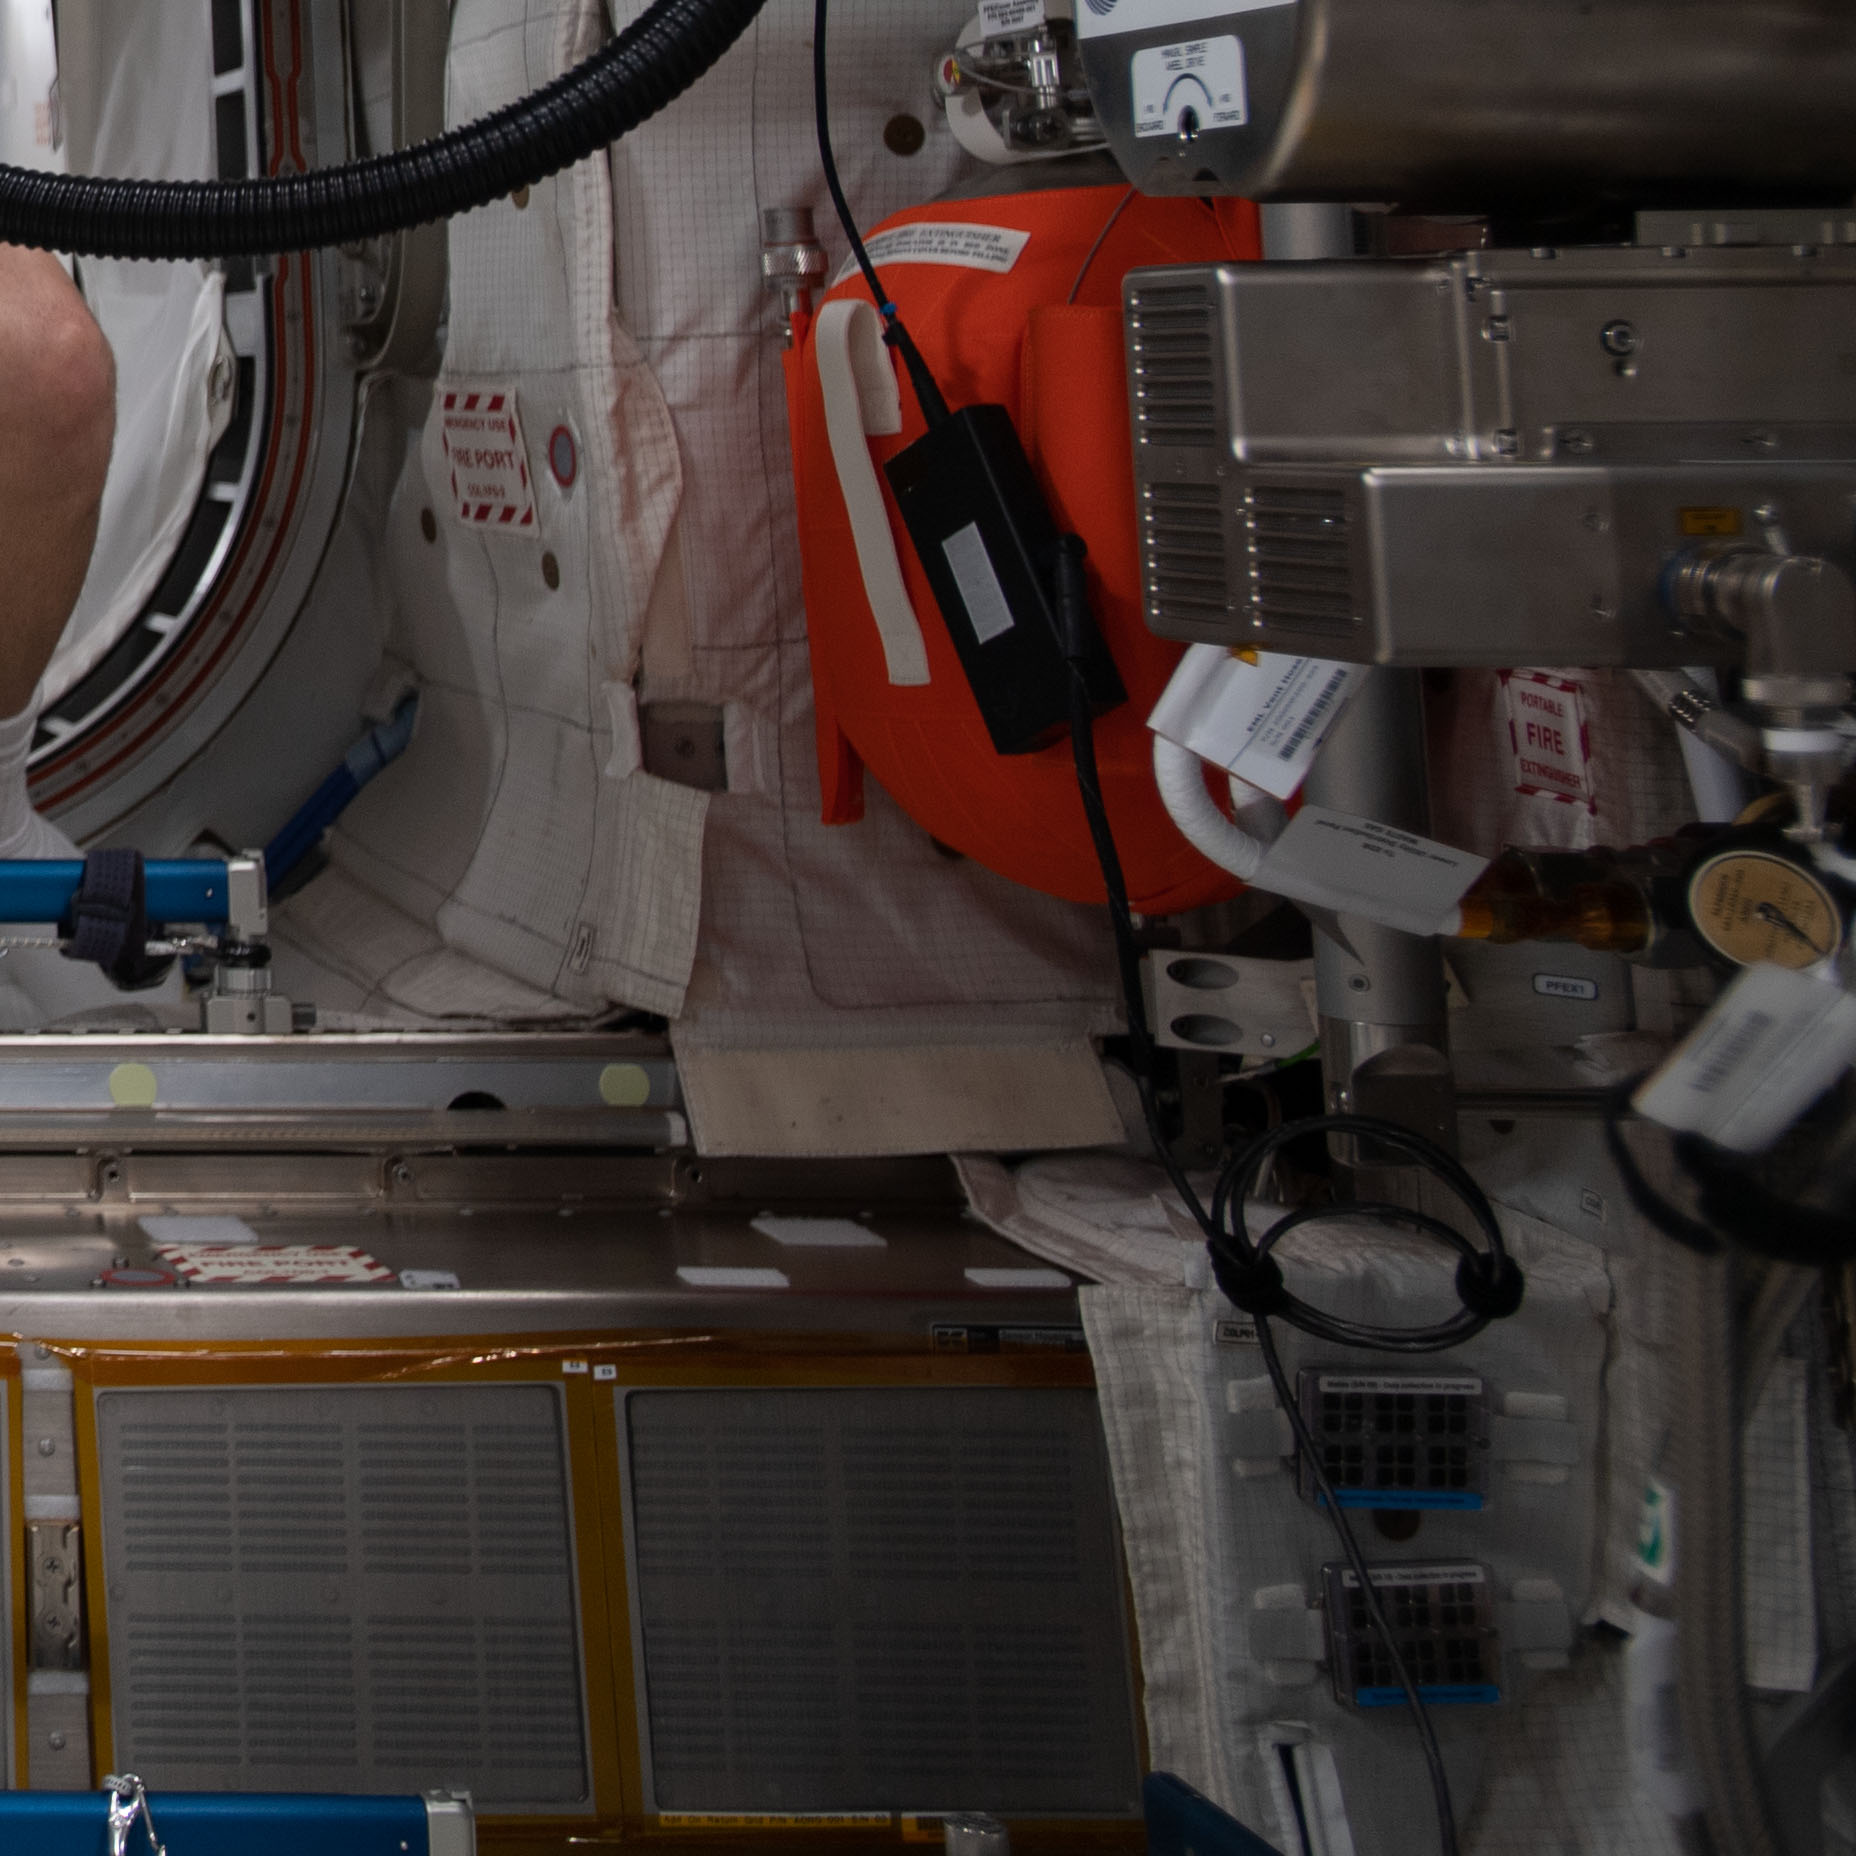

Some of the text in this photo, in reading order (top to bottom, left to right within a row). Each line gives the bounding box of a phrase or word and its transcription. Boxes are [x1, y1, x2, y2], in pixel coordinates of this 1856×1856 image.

[920, 228, 1002, 242] EXTINGUISHER
[475, 448, 516, 472] PORT
[1246, 685, 1283, 733] EML Vent
[1520, 692, 1564, 718] PORTABLE
[1526, 722, 1566, 756] FIRE
[1520, 756, 1581, 788] EXTINGUISHER
[200, 1258, 356, 1270] FIRE PORT
